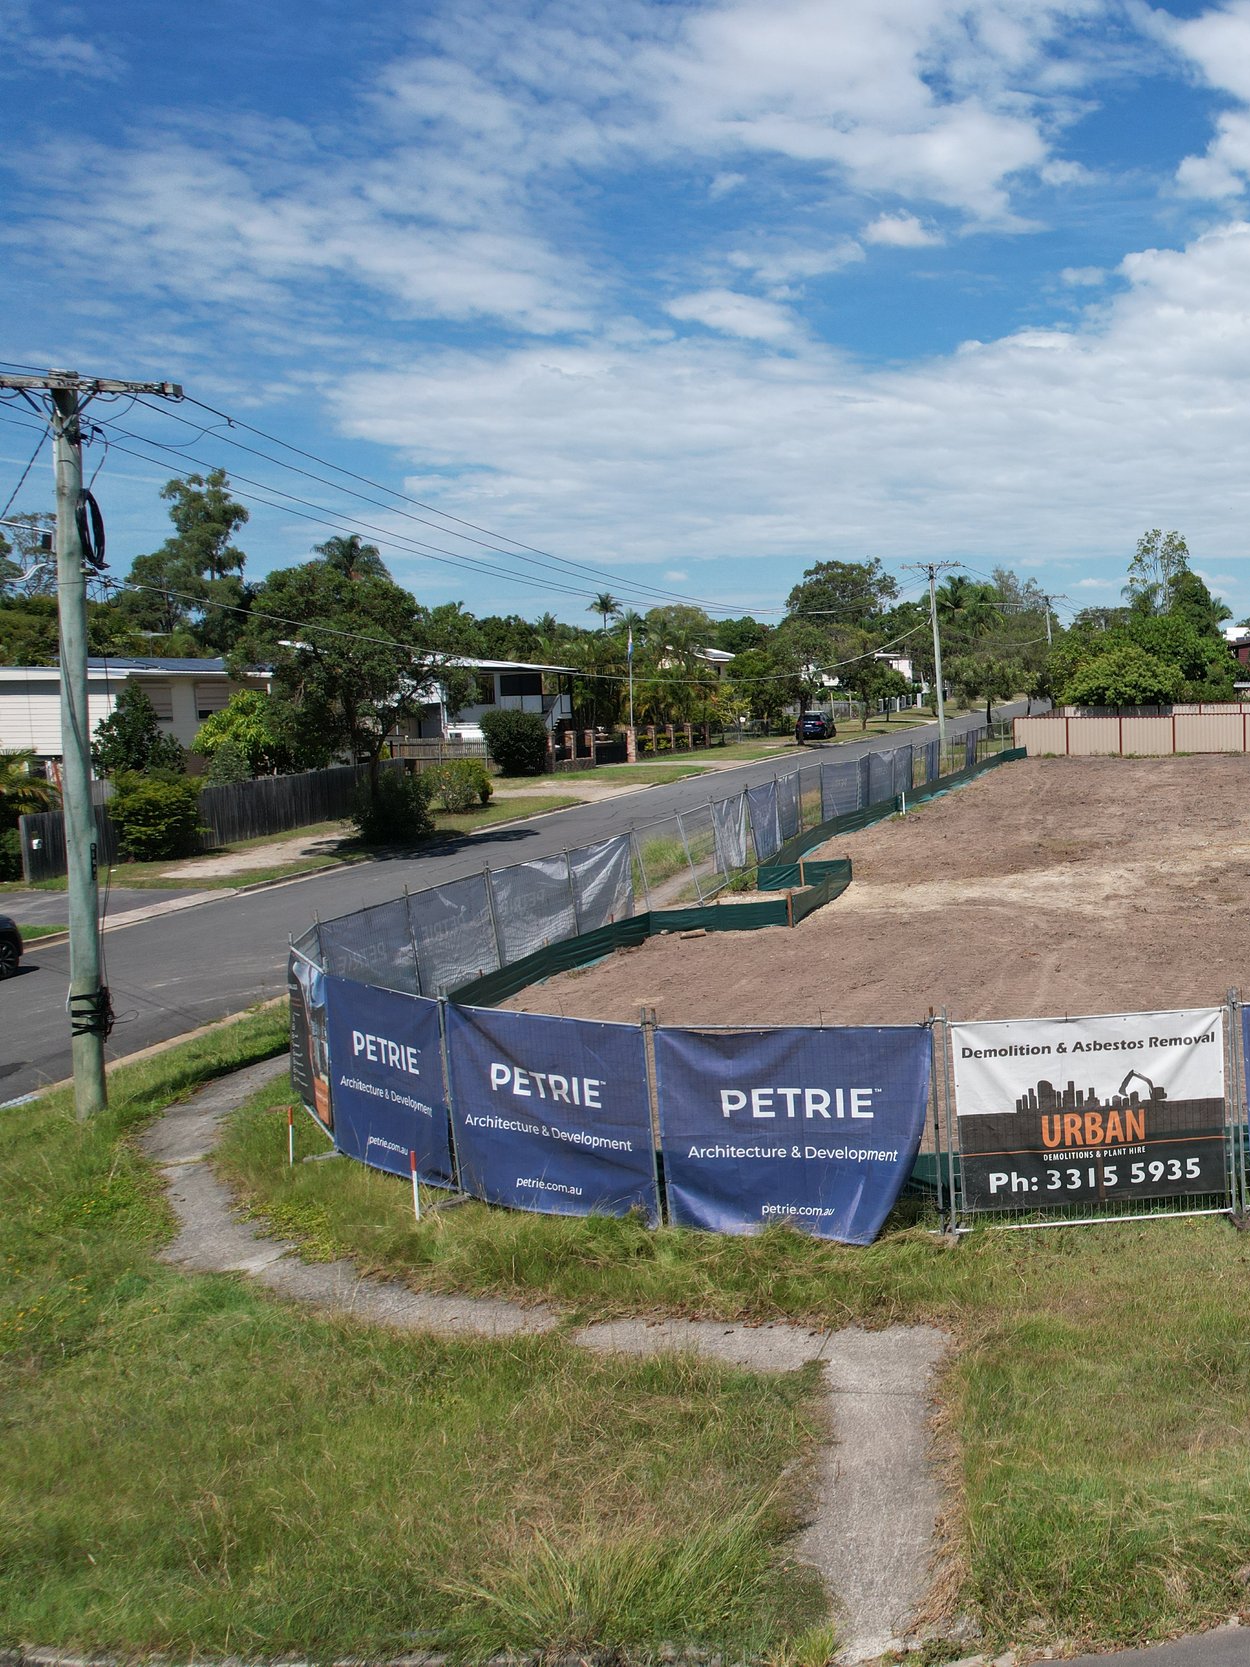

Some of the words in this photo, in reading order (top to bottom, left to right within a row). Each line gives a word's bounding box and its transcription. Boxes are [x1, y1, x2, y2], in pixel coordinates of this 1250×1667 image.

[962, 1043, 1051, 1058] Demolition
[1056, 1042, 1068, 1053] &
[1072, 1039, 1144, 1053] Asbestos
[1149, 1032, 1215, 1048] Removal
[340, 1075, 383, 1098] Architecture
[385, 1088, 390, 1098] &
[391, 1089, 432, 1118] Development
[465, 1114, 539, 1134] Architecture
[541, 1125, 550, 1137] &
[552, 1127, 632, 1152] Development
[1042, 1109, 1146, 1147] URBAN
[369, 1134, 408, 1156] petrie.com.au
[688, 1145, 786, 1158] Architecture
[792, 1146, 801, 1158] &
[805, 1146, 898, 1162] Development
[1044, 1151, 1094, 1161] DEMOLITIONS
[1096, 1150, 1101, 1158] &
[1104, 1148, 1126, 1157] PLANT
[1129, 1146, 1146, 1154] HIRE
[516, 1176, 582, 1196] petrie.com.au
[989, 1172, 1038, 1194] Ph:
[1046, 1166, 1118, 1189] 3315
[1130, 1158, 1200, 1183] 5935
[762, 1204, 834, 1216] petrie.com.au
